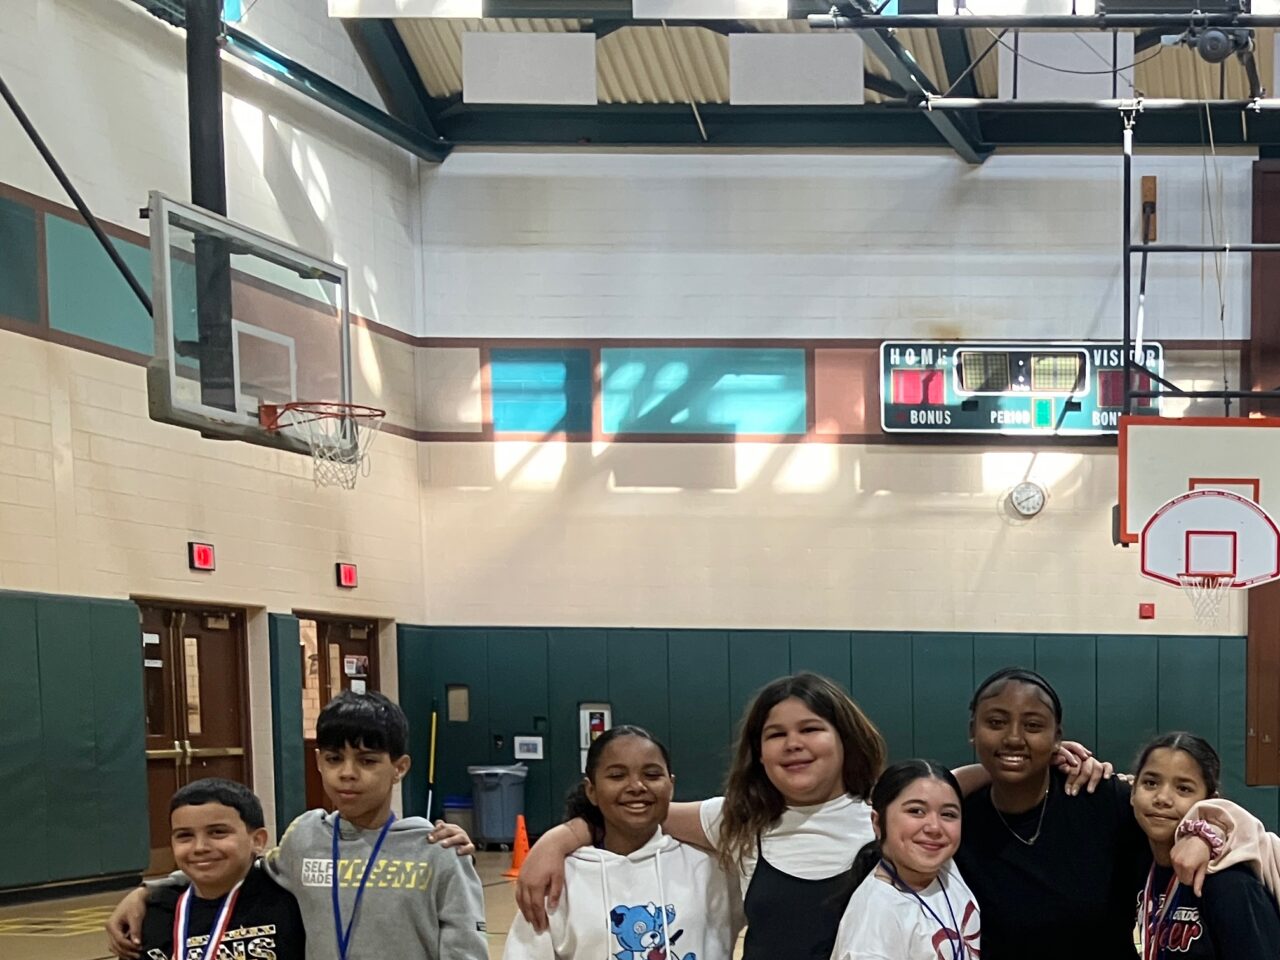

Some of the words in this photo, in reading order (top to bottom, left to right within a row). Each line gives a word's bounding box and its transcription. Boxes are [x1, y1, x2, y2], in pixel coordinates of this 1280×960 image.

[890, 348, 948, 366] HOME
[910, 410, 952, 425] BONUS
[990, 410, 1031, 425] PERIOD
[1092, 411, 1122, 426] BON
[304, 861, 333, 873] SELF
[303, 874, 333, 885] MADE
